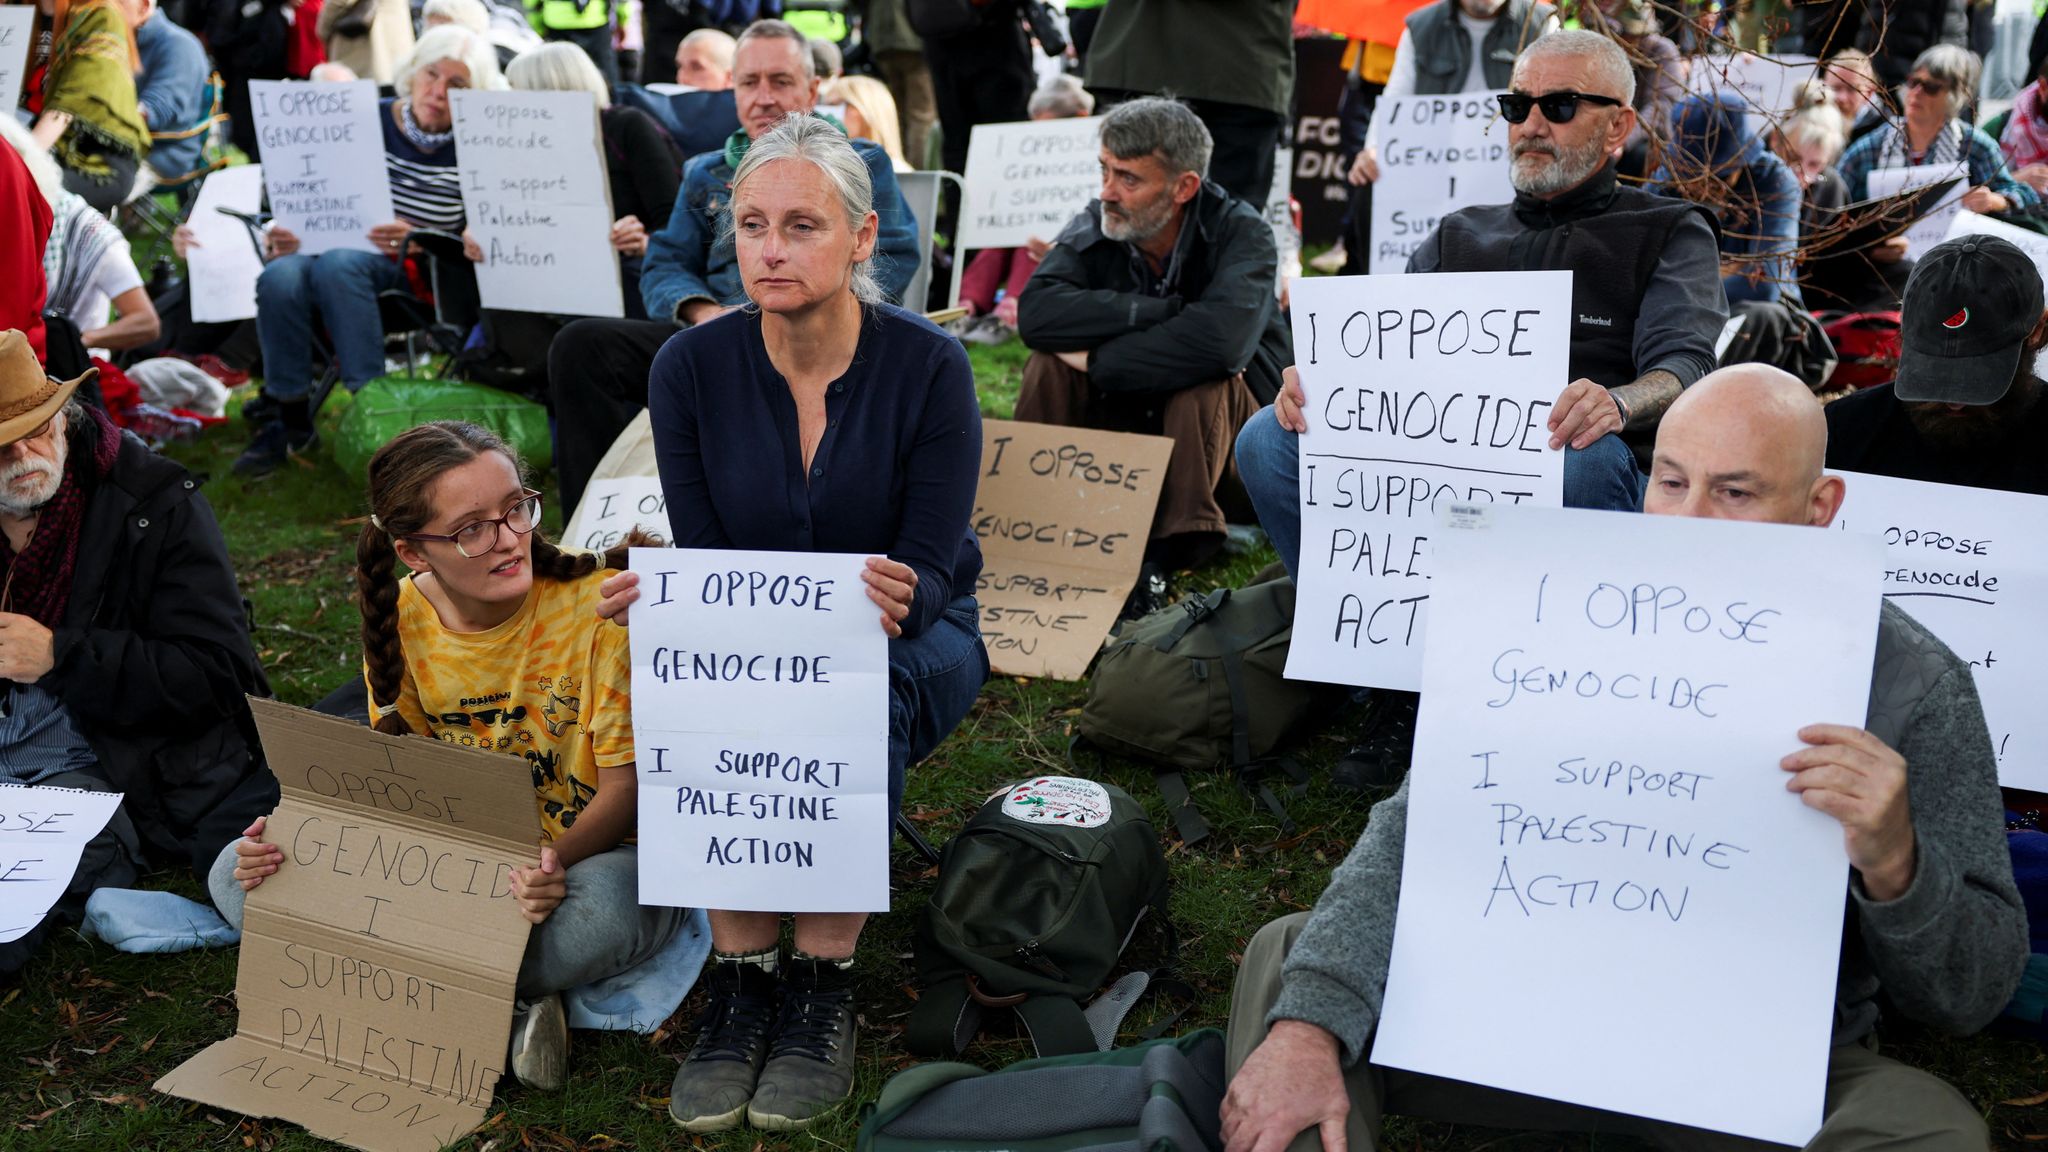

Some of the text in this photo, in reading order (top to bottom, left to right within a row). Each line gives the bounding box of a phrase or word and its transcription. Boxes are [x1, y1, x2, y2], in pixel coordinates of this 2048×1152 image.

[257, 89, 353, 117] I OPPOSE
[454, 97, 553, 128] I oppose
[1390, 98, 1496, 125] I OPPOS
[262, 122, 356, 149] GENOCIDE
[1385, 138, 1503, 166] GENOCID
[301, 153, 317, 176] I
[273, 178, 328, 196] SUPPORT
[467, 170, 568, 198] I support
[1010, 182, 1100, 207] SUPPORT
[1448, 177, 1456, 198] I
[275, 194, 361, 214] PALESTINE
[478, 202, 557, 228] Palestine
[977, 212, 1060, 229] PALESTINE
[305, 215, 362, 232] ACTION
[1391, 211, 1441, 236] SUP
[490, 236, 556, 267] Action
[1309, 309, 1540, 365] I OPPOSE
[1579, 314, 1612, 327] Timberland
[1325, 387, 1552, 452] GENOCIDE
[986, 436, 1150, 491] I OPPOSE
[1306, 465, 1318, 505] I
[597, 493, 620, 521] I
[1328, 528, 1433, 580] PALE
[649, 570, 835, 612] I OPPOSE
[1535, 573, 1782, 644] I OPPOSE
[978, 604, 1088, 632] STINE
[1334, 593, 1430, 648] ACT
[652, 647, 832, 684] GENOCIDE
[1486, 648, 1729, 718] GENOCIDE
[368, 740, 416, 780] I
[647, 748, 850, 789] I SUPPORT
[1471, 751, 1714, 801] I SUPPORT
[306, 764, 465, 823] OPPOSE
[676, 786, 840, 821] PALESTINE
[706, 836, 814, 868] ACTION
[1491, 802, 1750, 870] PALESTINE
[293, 816, 515, 900] GENOCID
[1484, 855, 1689, 922] ACTION
[359, 895, 392, 938] I
[279, 943, 446, 1012] SUPPORT
[281, 1007, 502, 1109] PALESTINE
[218, 1056, 441, 1128] ACTION
